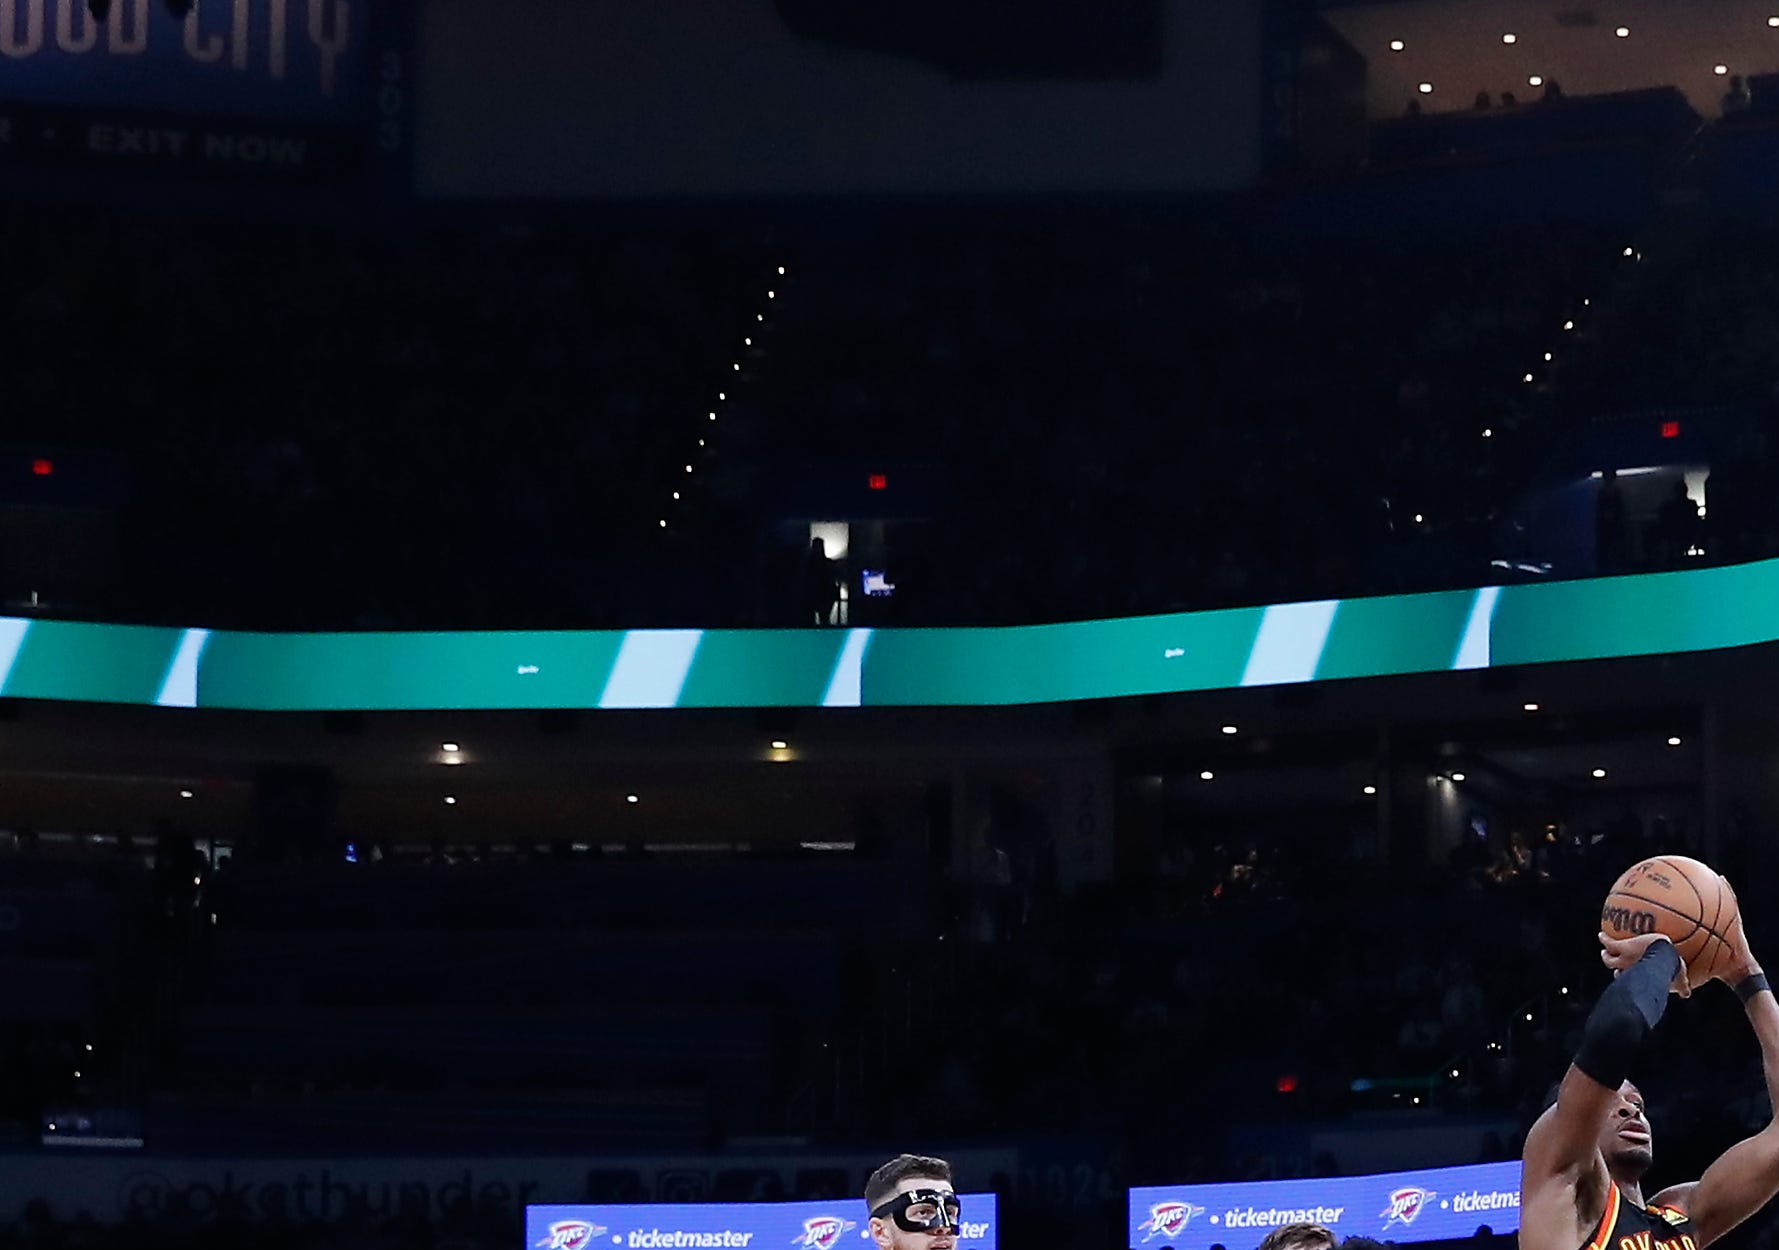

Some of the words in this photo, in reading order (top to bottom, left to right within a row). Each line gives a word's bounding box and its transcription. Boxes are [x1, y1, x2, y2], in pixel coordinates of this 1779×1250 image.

[88, 124, 190, 156] EXIT
[205, 132, 307, 164] NOW
[1223, 1206, 1344, 1229] ticketmaster
[628, 1228, 753, 1249] ticketmaster
